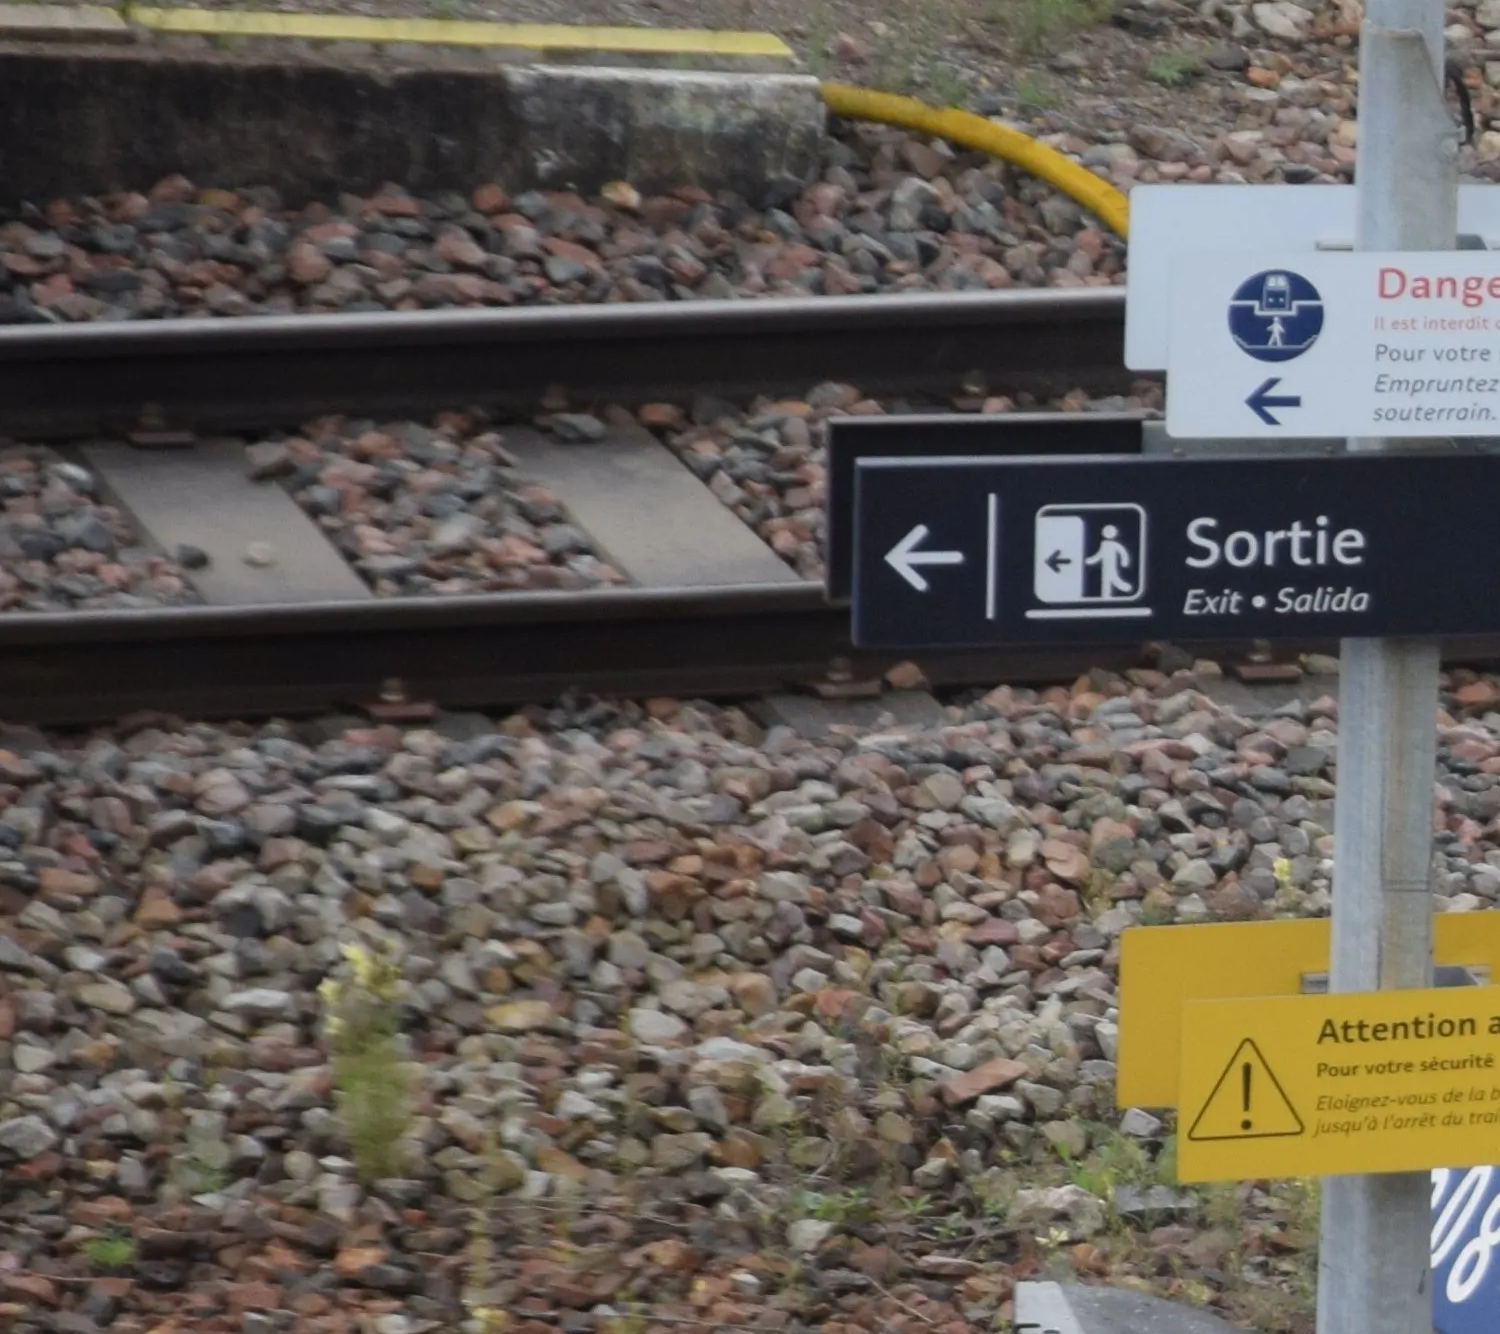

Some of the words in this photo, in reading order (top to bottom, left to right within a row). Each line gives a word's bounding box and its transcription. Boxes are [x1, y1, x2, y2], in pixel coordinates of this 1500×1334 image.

[1391, 318, 1416, 331] est
[1423, 316, 1488, 331] interdit
[1374, 344, 1426, 363] Pour
[1433, 346, 1491, 362] votre
[1374, 373, 1499, 397] Empruntez
[1372, 403, 1498, 423] souterrain.
[1184, 515, 1367, 568] Sortie
[1183, 588, 1244, 615] Exit
[1274, 586, 1371, 613] Salida
[1316, 1012, 1477, 1044] Attention
[1316, 1062, 1360, 1078] Pour
[1364, 1060, 1414, 1075] votre
[1420, 1053, 1495, 1072] sécurité
[1316, 1090, 1438, 1113] Eloignez-vous
[1442, 1087, 1464, 1103] de
[1468, 1087, 1486, 1102] la
[1441, 1112, 1464, 1128] du
